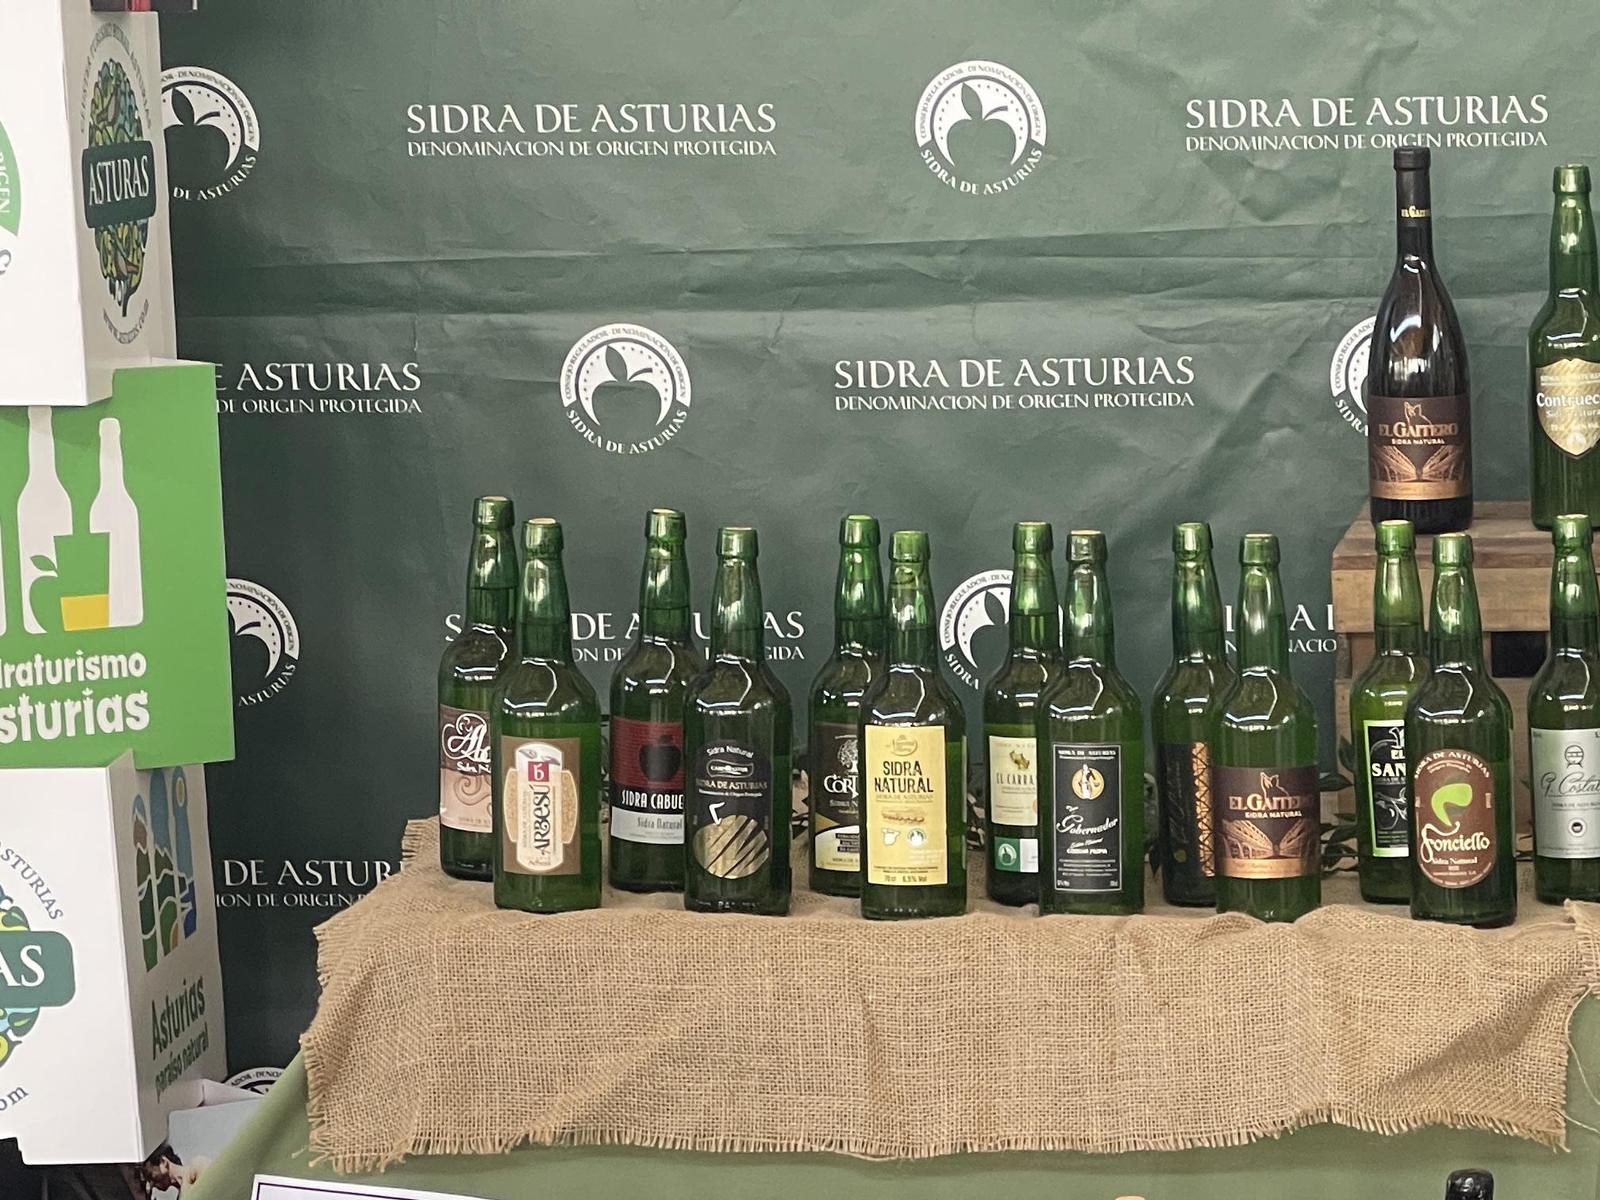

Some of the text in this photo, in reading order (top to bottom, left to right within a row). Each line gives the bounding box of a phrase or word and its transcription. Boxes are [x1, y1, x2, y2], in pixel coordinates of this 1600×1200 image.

[407, 102, 777, 135] SIDRA DE ASTURIAS
[1185, 93, 1548, 130] SIDRA DE ASTURIAS
[407, 139, 777, 157] DENOMINACION DE ORIGEN PROTEGIDA
[1185, 131, 1549, 153] DENOMINACION DE ORIGEN PROTEGIDA
[236, 362, 422, 392] ASTURIAS
[835, 355, 1195, 390] SIDRA DE ASTURIAS
[242, 397, 422, 415] ORIGEN PROTEGIDA
[834, 391, 1195, 412] DENOMINACION DE ORIGEN PROTEGIDA
[566, 408, 601, 450] SIDRA
[629, 409, 688, 455] ASTURIAS
[0, 688, 151, 744] sturias
[883, 760, 922, 776] SIDRA
[621, 789, 648, 807] SIDRA
[650, 790, 685, 809] CABUE
[874, 777, 934, 793] NATURAL
[151, 978, 206, 1059] Asturias
[154, 1027, 210, 1104] paraíso natural
